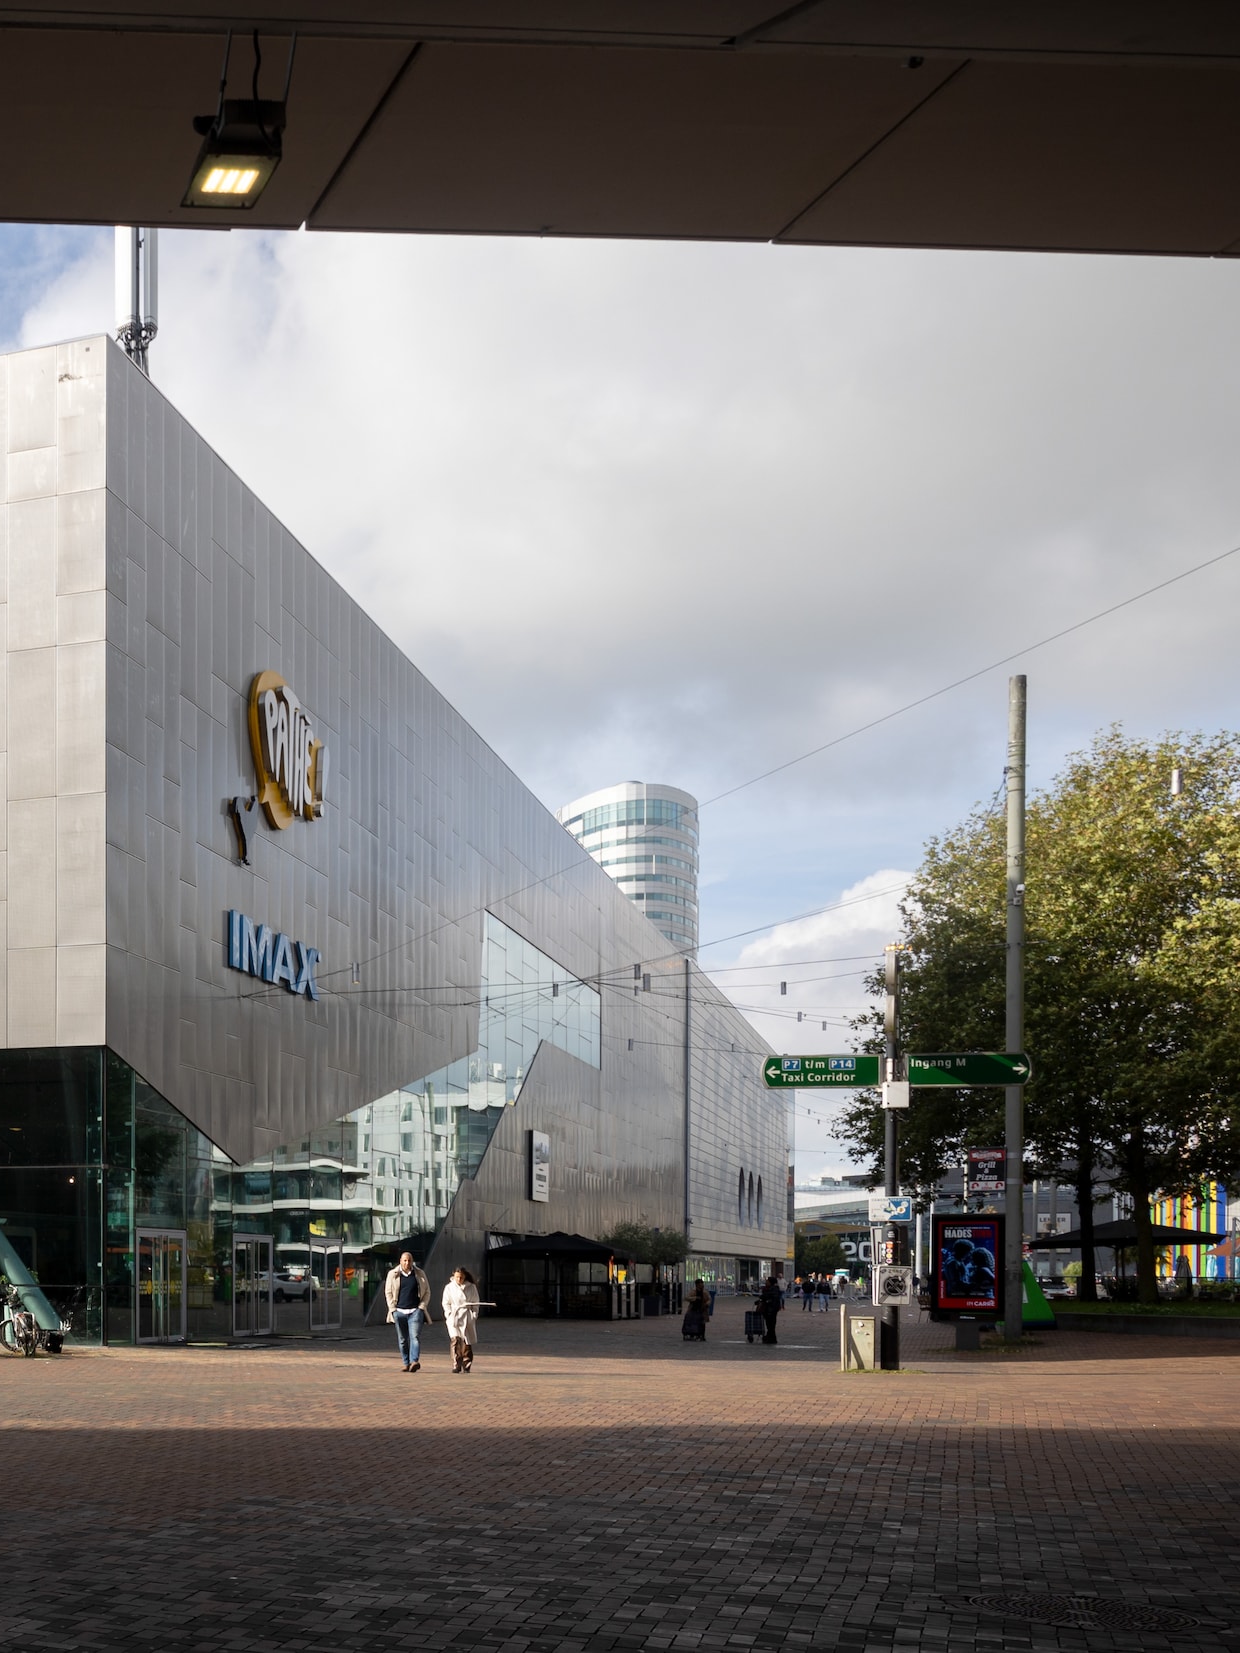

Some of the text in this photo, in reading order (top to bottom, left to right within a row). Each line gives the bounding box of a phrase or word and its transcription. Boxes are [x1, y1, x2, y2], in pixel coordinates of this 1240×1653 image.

[228, 909, 320, 1001] IMAX
[805, 1060, 825, 1069] t/m
[910, 1058, 966, 1069] Ingang M
[781, 1072, 856, 1082] Taxi Corridor
